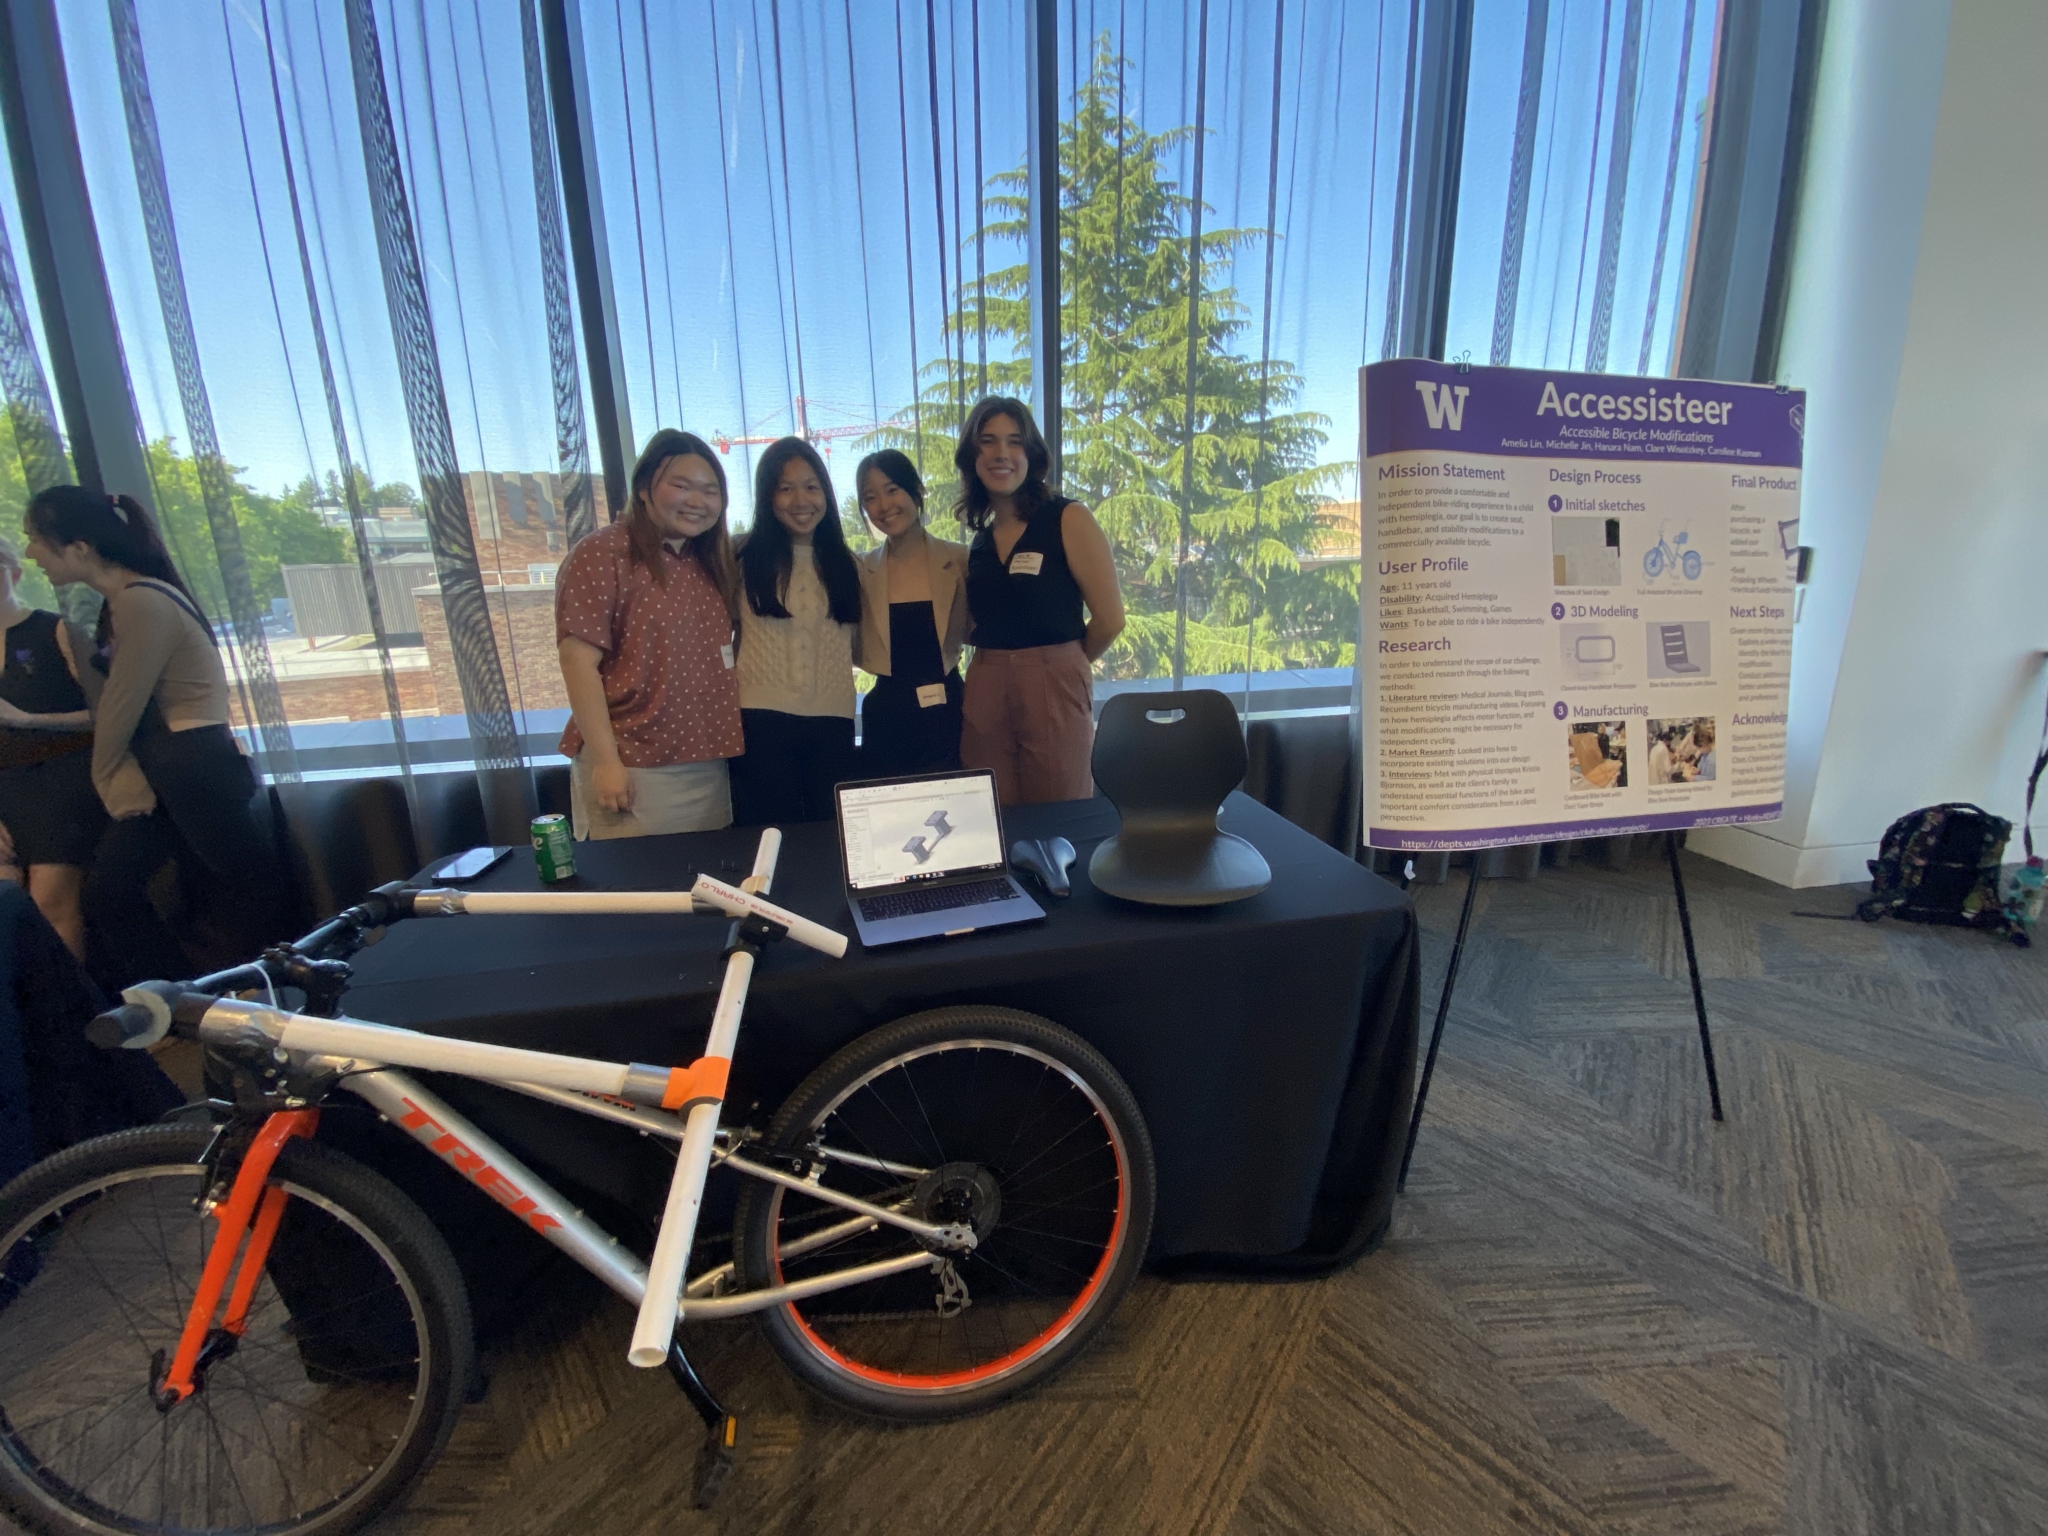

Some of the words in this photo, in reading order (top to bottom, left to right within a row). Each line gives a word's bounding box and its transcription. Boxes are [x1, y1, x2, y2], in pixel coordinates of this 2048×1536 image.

[1416, 380, 1469, 431] W
[1537, 381, 1732, 426] Accessisteer
[1559, 425, 1609, 439] Accessible
[1612, 427, 1648, 443] Bicycle
[1650, 429, 1714, 443] Modifications
[1501, 438, 1528, 448] Amelia
[1530, 439, 1544, 449] Lin,
[1546, 440, 1579, 450] Michelle
[1581, 442, 1593, 451] Jin,
[1379, 463, 1439, 481] Mission
[1443, 463, 1505, 481] Statement
[1550, 468, 1590, 485] Design
[1595, 470, 1641, 484] Process
[1732, 475, 1756, 488] Final
[1759, 476, 1797, 490] Product
[1389, 488, 1412, 498] order
[1425, 487, 1452, 496] provide
[1460, 488, 1496, 497] comfortable
[1378, 500, 1431, 512] independent
[1433, 500, 1469, 509] bike-riding
[1471, 502, 1504, 510] experience
[1566, 499, 1595, 511] Initial
[1598, 499, 1645, 512] sketches
[1378, 516, 1397, 525] with
[1400, 513, 1444, 521] hemiplegia,
[1460, 513, 1473, 521] goal
[1490, 515, 1508, 523] create
[1378, 526, 1423, 537] handlebar,
[1425, 525, 1439, 533] and
[1441, 525, 1468, 534] stability
[1470, 526, 1511, 535] modifications
[1378, 538, 1433, 550] commercially
[1435, 538, 1466, 546] available
[1379, 561, 1417, 575] User
[1422, 557, 1468, 572] Profile
[1380, 584, 1399, 594] Age:
[1402, 582, 1412, 590] 11
[1416, 582, 1437, 590] years
[1380, 595, 1423, 605] Disability:
[1425, 593, 1459, 602] Acquired
[1461, 593, 1498, 601] Hemiplegia
[1380, 609, 1404, 617] Likes:
[1407, 606, 1450, 615] Basketball,
[1452, 605, 1489, 614] Swimming,
[1571, 606, 1586, 617] 3D
[1590, 605, 1638, 618] Modeling
[1730, 606, 1756, 618] Next
[1759, 605, 1784, 620] Steps
[1380, 621, 1411, 629] Wants:
[1414, 619, 1424, 627] To
[1427, 618, 1436, 626] be
[1466, 617, 1479, 625] ride
[1379, 637, 1451, 653] Research
[1423, 659, 1462, 667] understand
[1464, 658, 1474, 666] the
[1393, 671, 1434, 679] conducted
[1436, 669, 1465, 677] research
[1467, 669, 1491, 677] through
[1503, 668, 1529, 676] following
[1389, 694, 1427, 703] Literature
[1430, 693, 1459, 701] reviews:
[1380, 704, 1423, 713] Recumbent
[1426, 704, 1450, 713] bicycle
[1452, 701, 1498, 711] manufacturing
[1573, 703, 1648, 717] Manufacturing
[1411, 714, 1450, 723] hemiplegia
[1401, 725, 1451, 734] modifications
[1453, 725, 1472, 733] might
[1483, 723, 1512, 732] necessary
[1380, 738, 1428, 746] independent
[1430, 737, 1456, 746] cycling.
[1389, 749, 1417, 757] Market
[1420, 748, 1455, 756] Research:
[1380, 760, 1424, 768] incorporate
[1426, 759, 1454, 767] existing
[1512, 755, 1530, 763] design
[1389, 771, 1432, 779] Interviews:
[1451, 769, 1466, 777] with
[1468, 768, 1493, 777] physical
[1495, 767, 1521, 775] therapist
[1381, 782, 1416, 790] Bjornson,
[1455, 780, 1466, 788] the
[1380, 792, 1423, 800] understand
[1425, 791, 1457, 799] essential
[1459, 790, 1489, 798] functions
[1490, 789, 1497, 797] of
[1510, 787, 1522, 795] bike
[1381, 802, 1417, 811] important
[1420, 802, 1450, 810] comfort
[1452, 800, 1498, 810] considerations
[1381, 814, 1426, 822] perspective.
[698, 882, 745, 905] CHARLO
[399, 1097, 563, 1235] TREK
